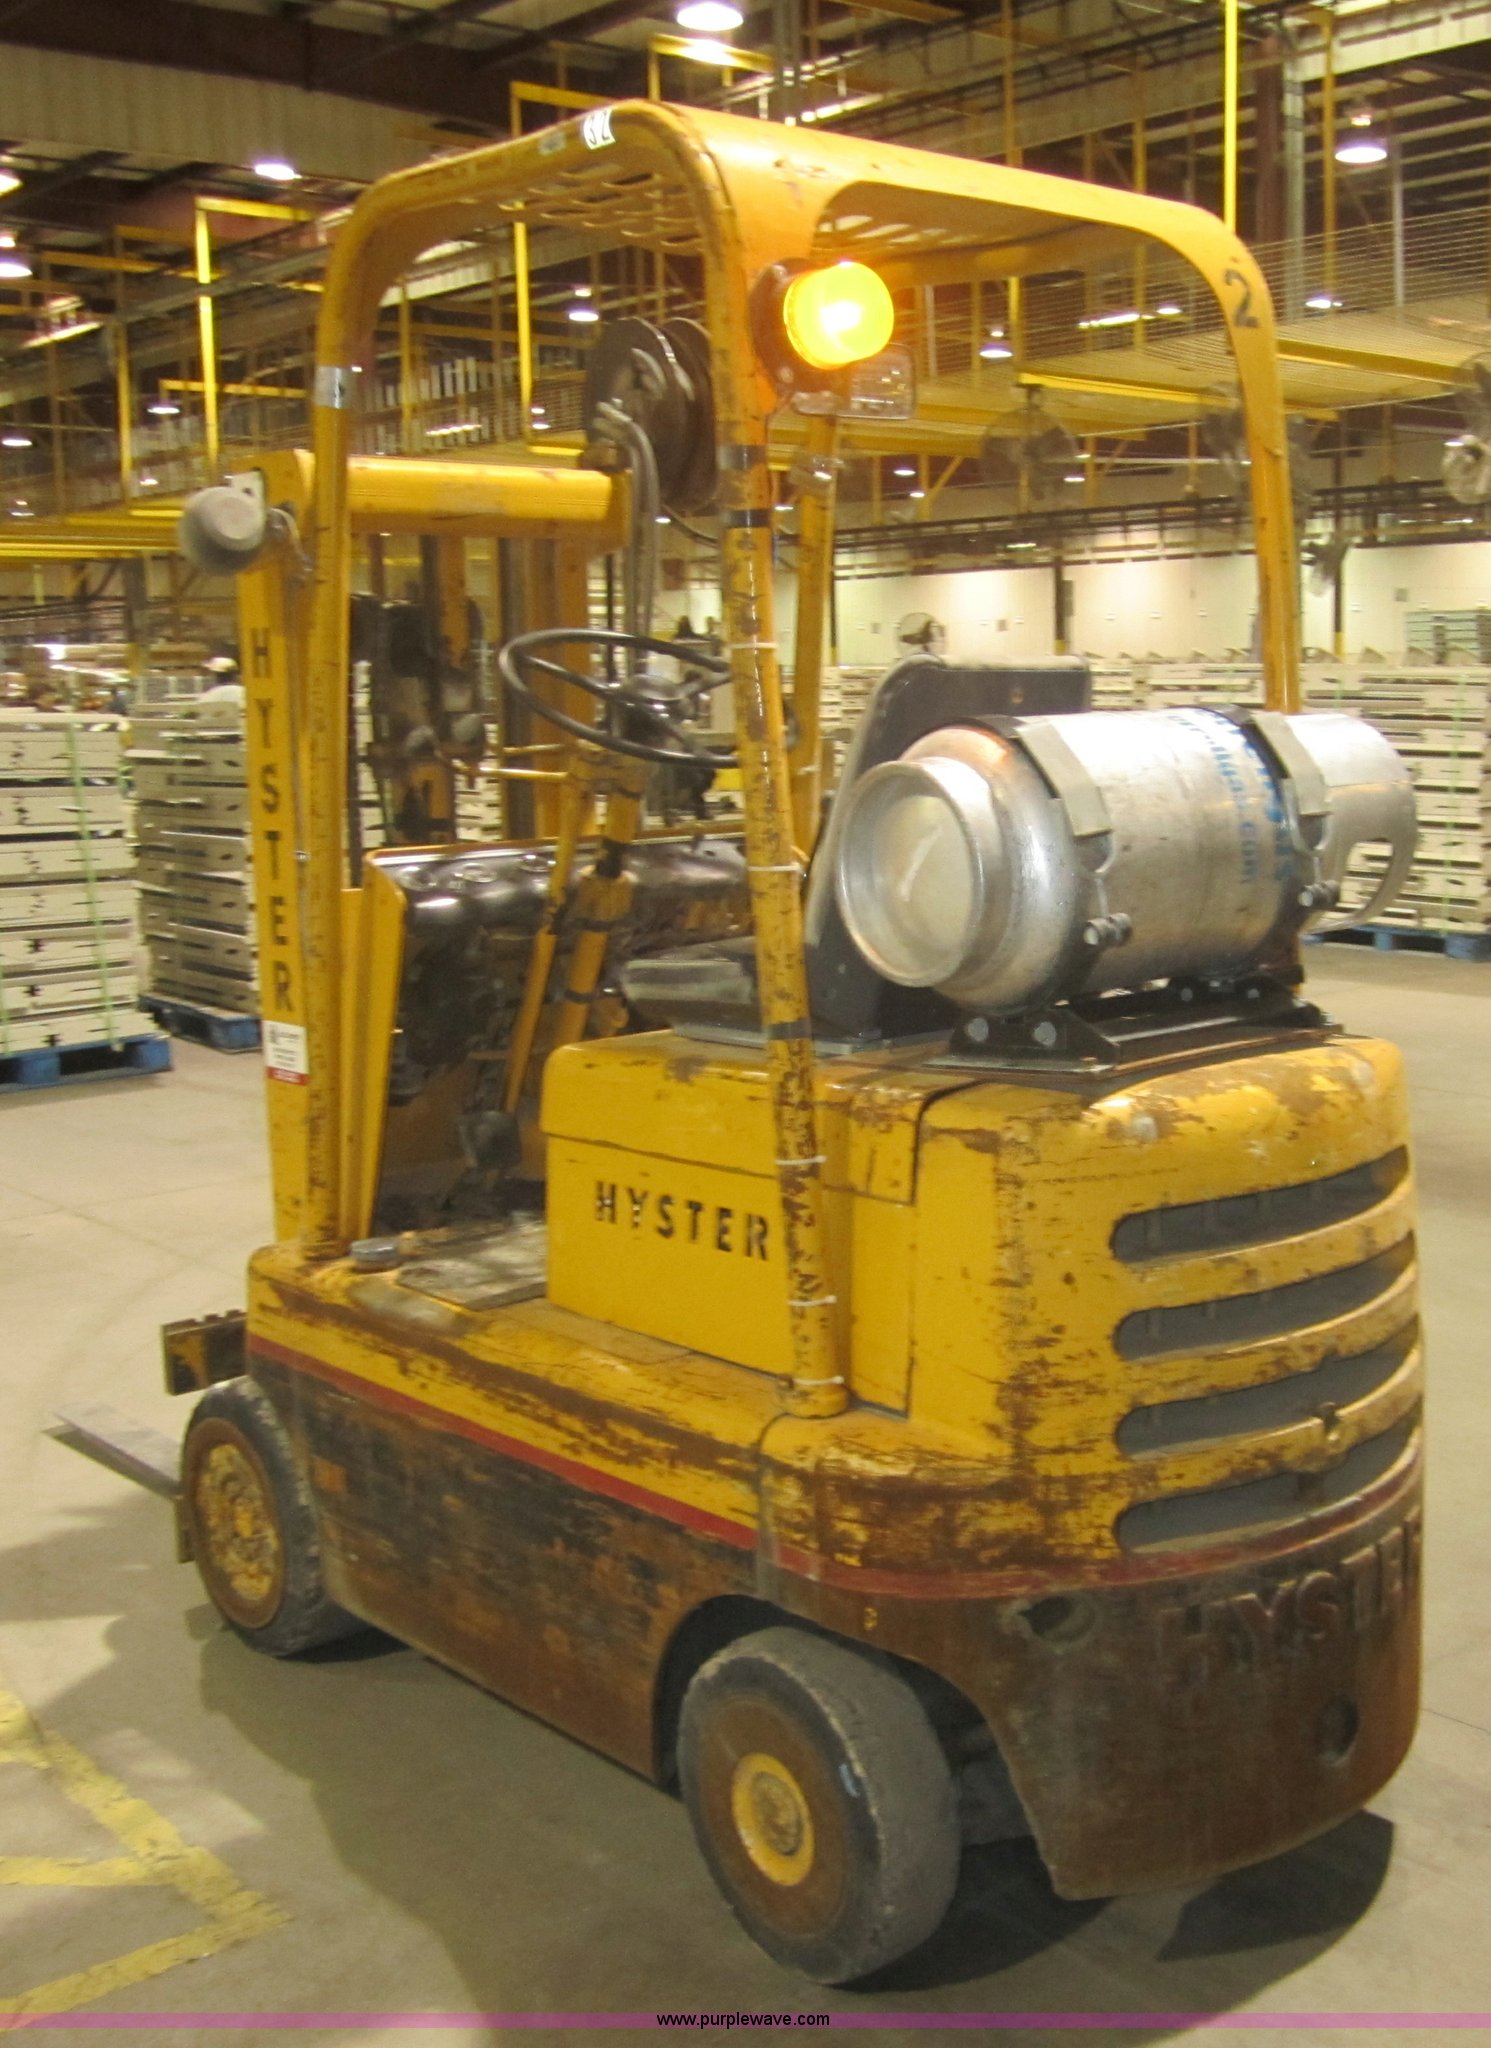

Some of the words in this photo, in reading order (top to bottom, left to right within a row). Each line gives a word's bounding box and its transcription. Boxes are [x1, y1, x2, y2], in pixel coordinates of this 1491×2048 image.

[1223, 268, 1259, 328] 2
[249, 626, 293, 1013] HYSTER
[595, 1180, 769, 1262] HYSTER
